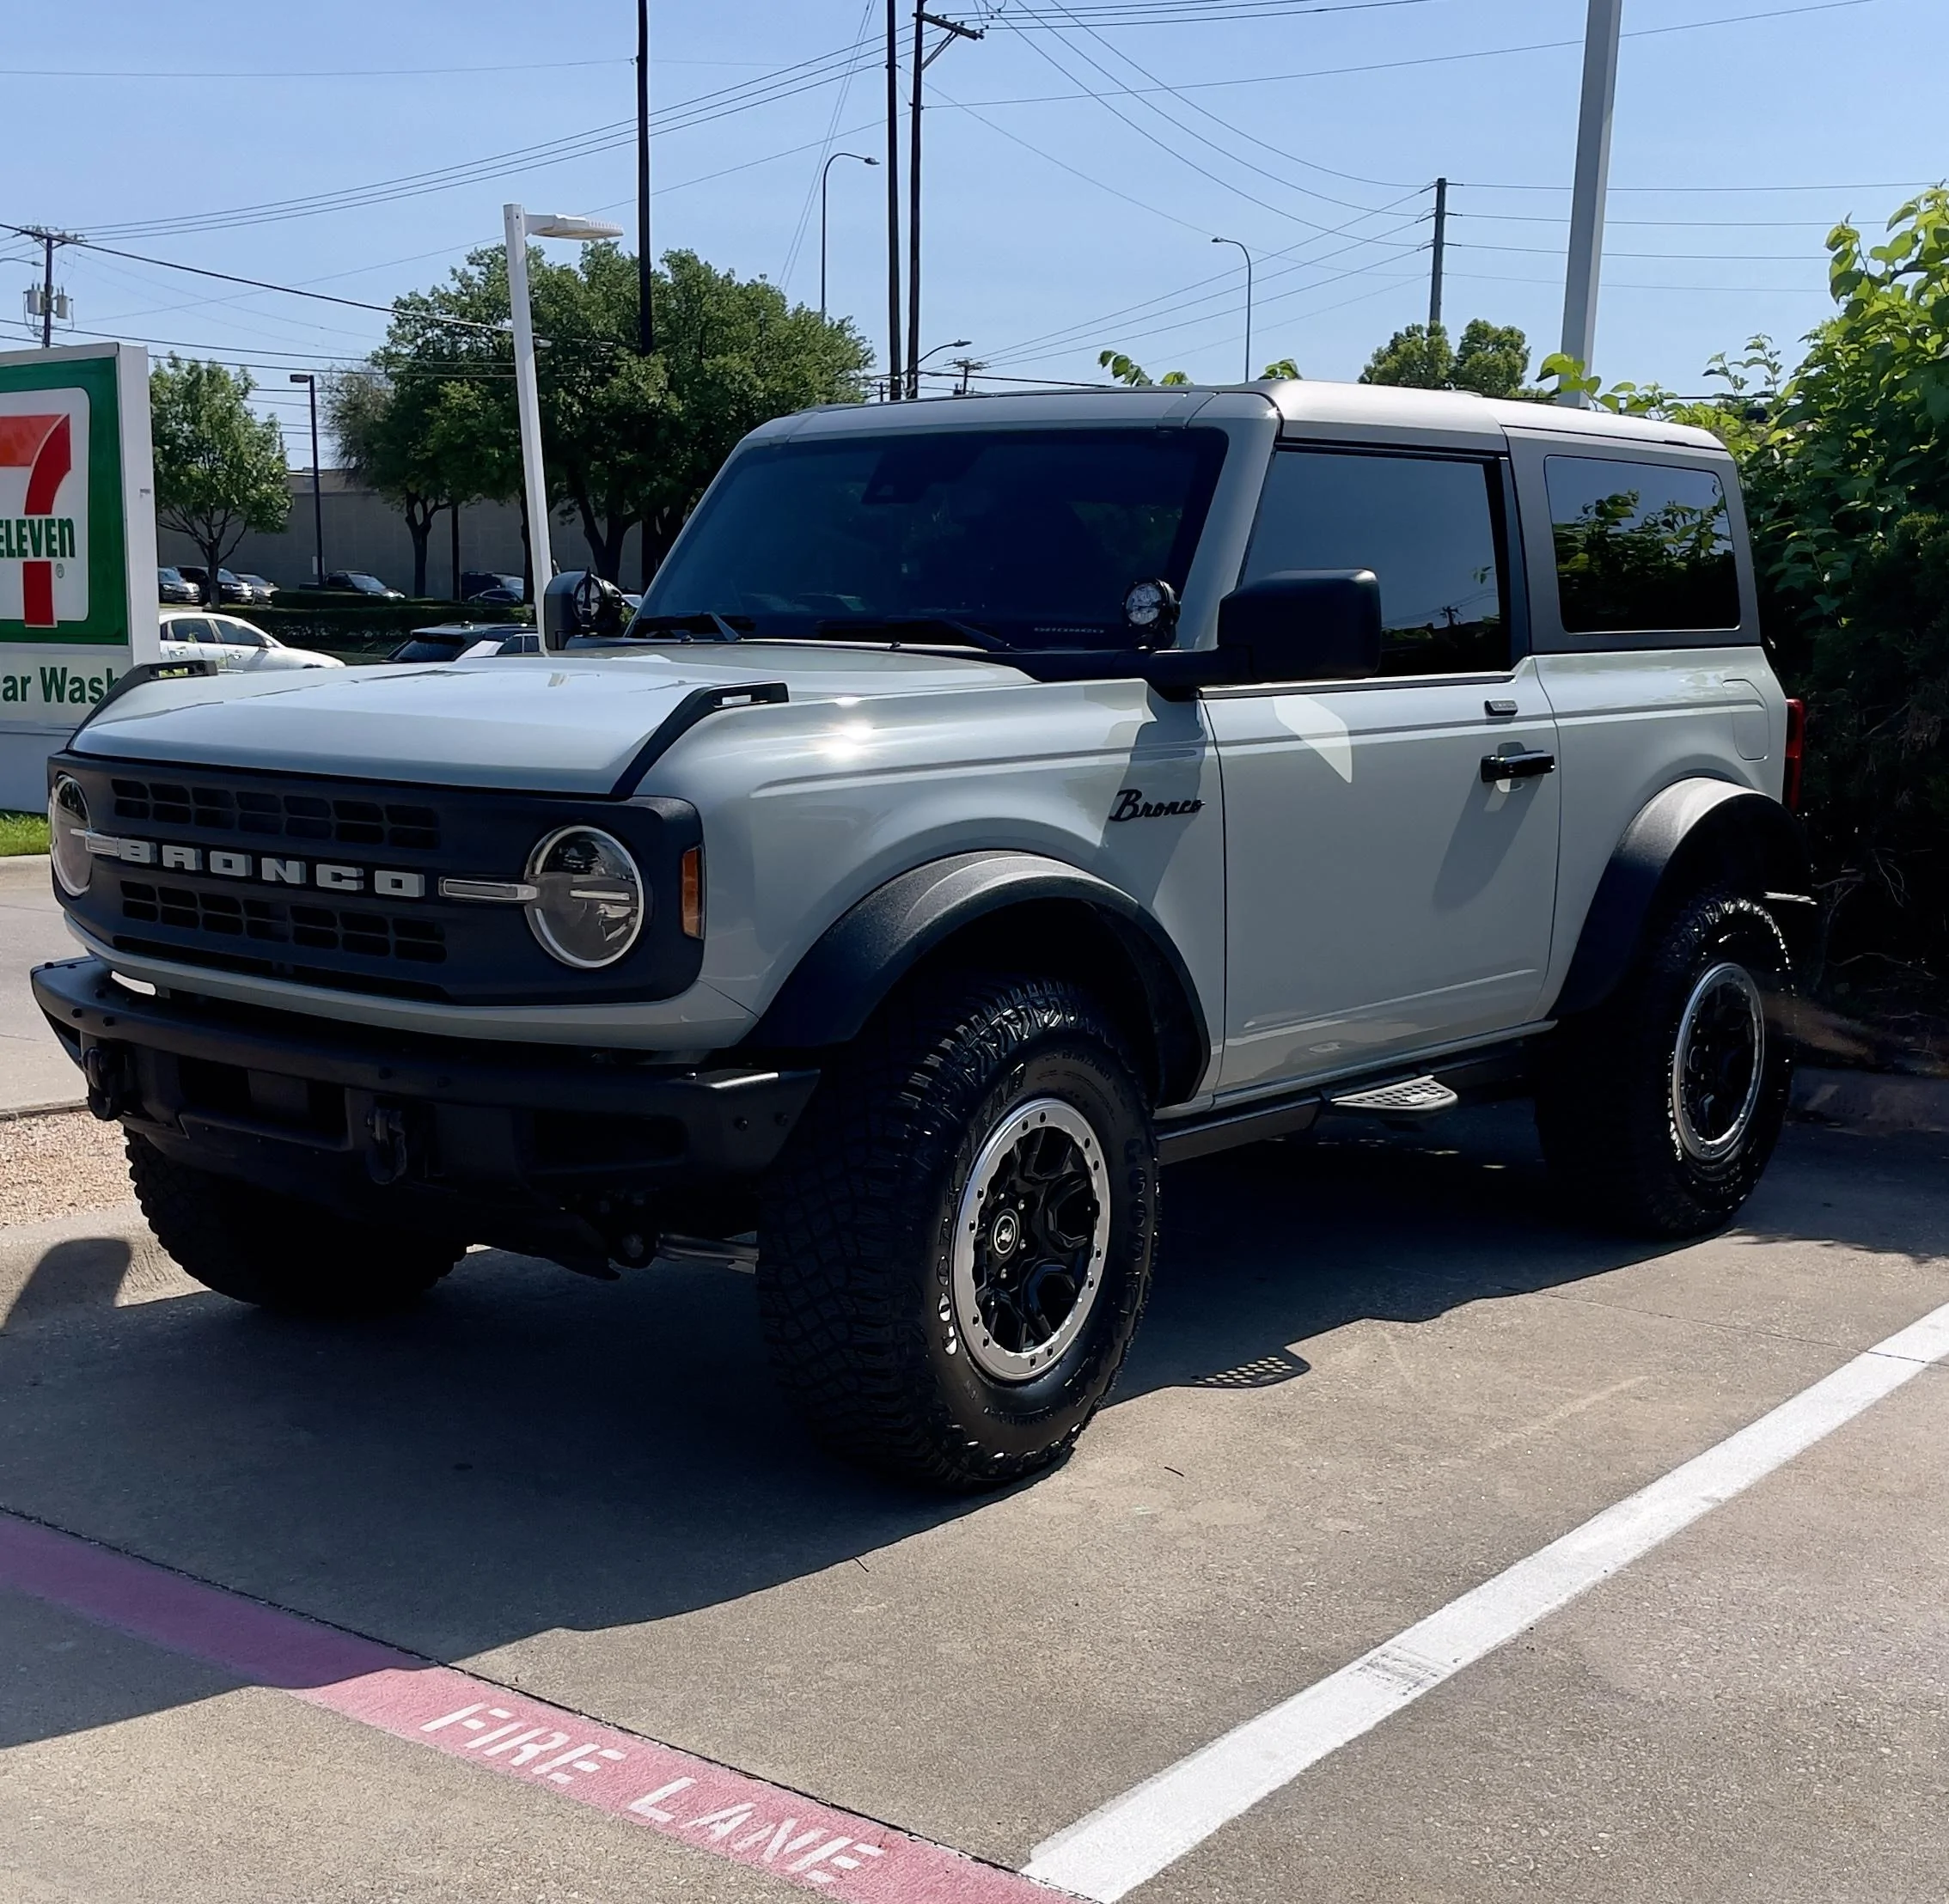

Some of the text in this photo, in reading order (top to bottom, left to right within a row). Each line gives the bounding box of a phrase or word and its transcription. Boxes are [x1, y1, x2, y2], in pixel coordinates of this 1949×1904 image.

[0, 675, 32, 702] ar
[1109, 789, 1207, 822] Bronco
[119, 838, 425, 898] BRONCO
[419, 1701, 886, 1885] FIRE LANE
